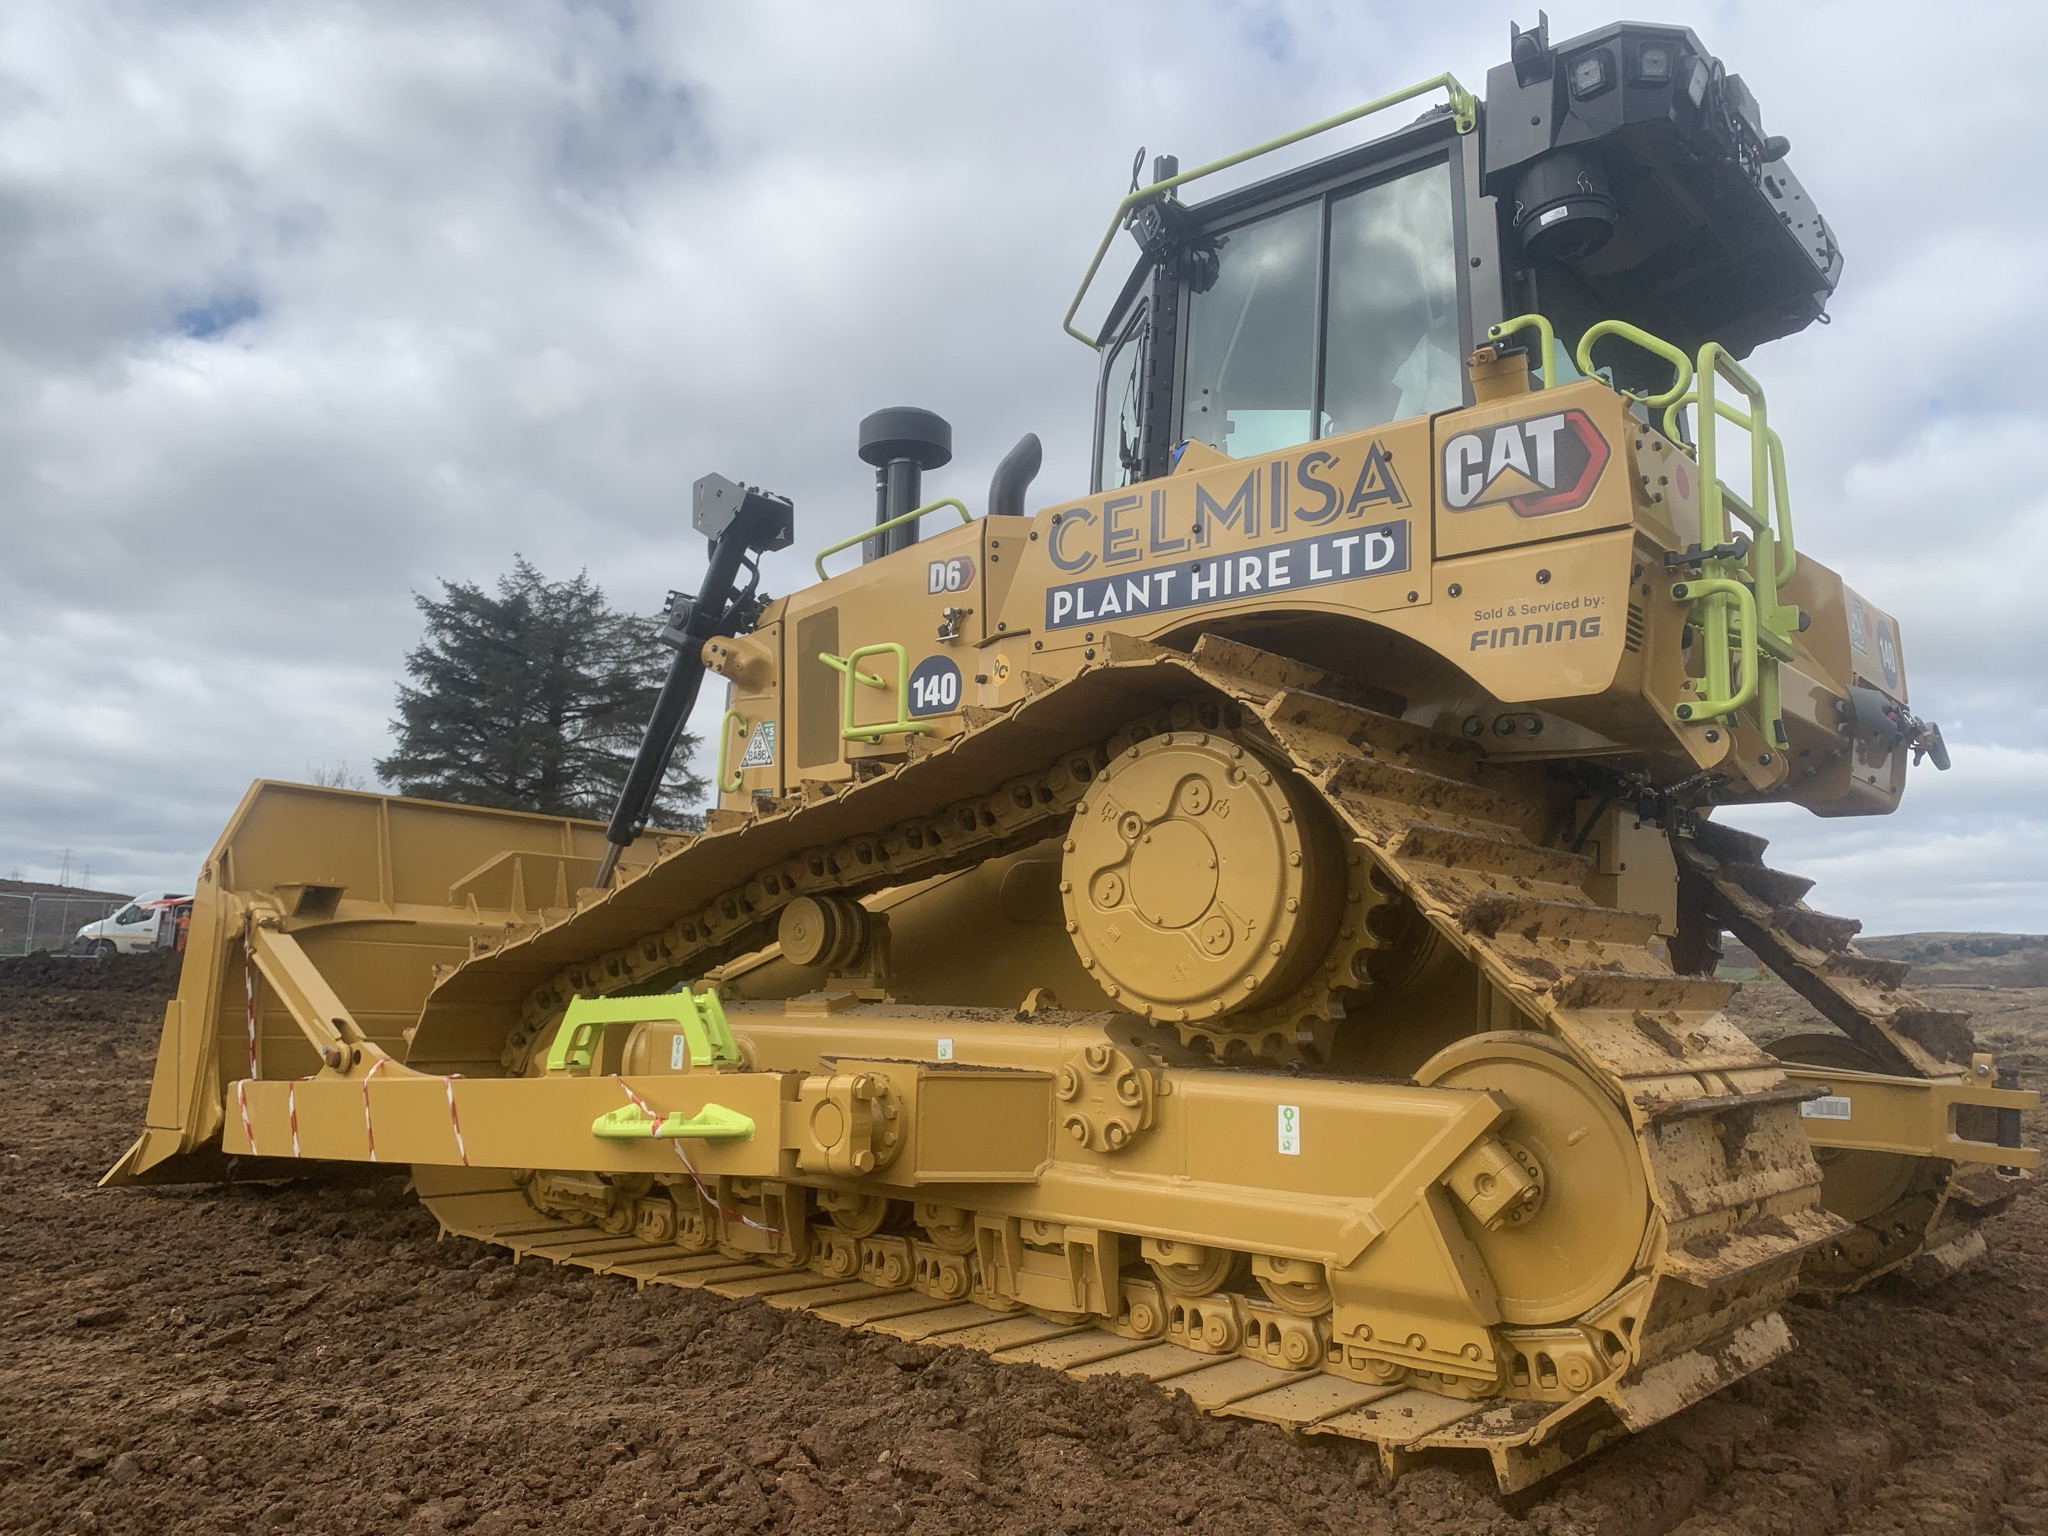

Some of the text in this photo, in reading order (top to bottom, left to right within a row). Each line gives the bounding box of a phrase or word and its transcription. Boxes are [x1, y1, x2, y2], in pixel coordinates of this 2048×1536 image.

[1445, 413, 1565, 507] CAT
[1048, 439, 1412, 575] CELMISA
[929, 560, 961, 594] D6
[1053, 531, 1395, 624] PLANT HIRE LTD
[1474, 596, 1605, 621] Sold & Serviced by:
[1470, 616, 1602, 651] FINNING
[912, 672, 957, 708] 140
